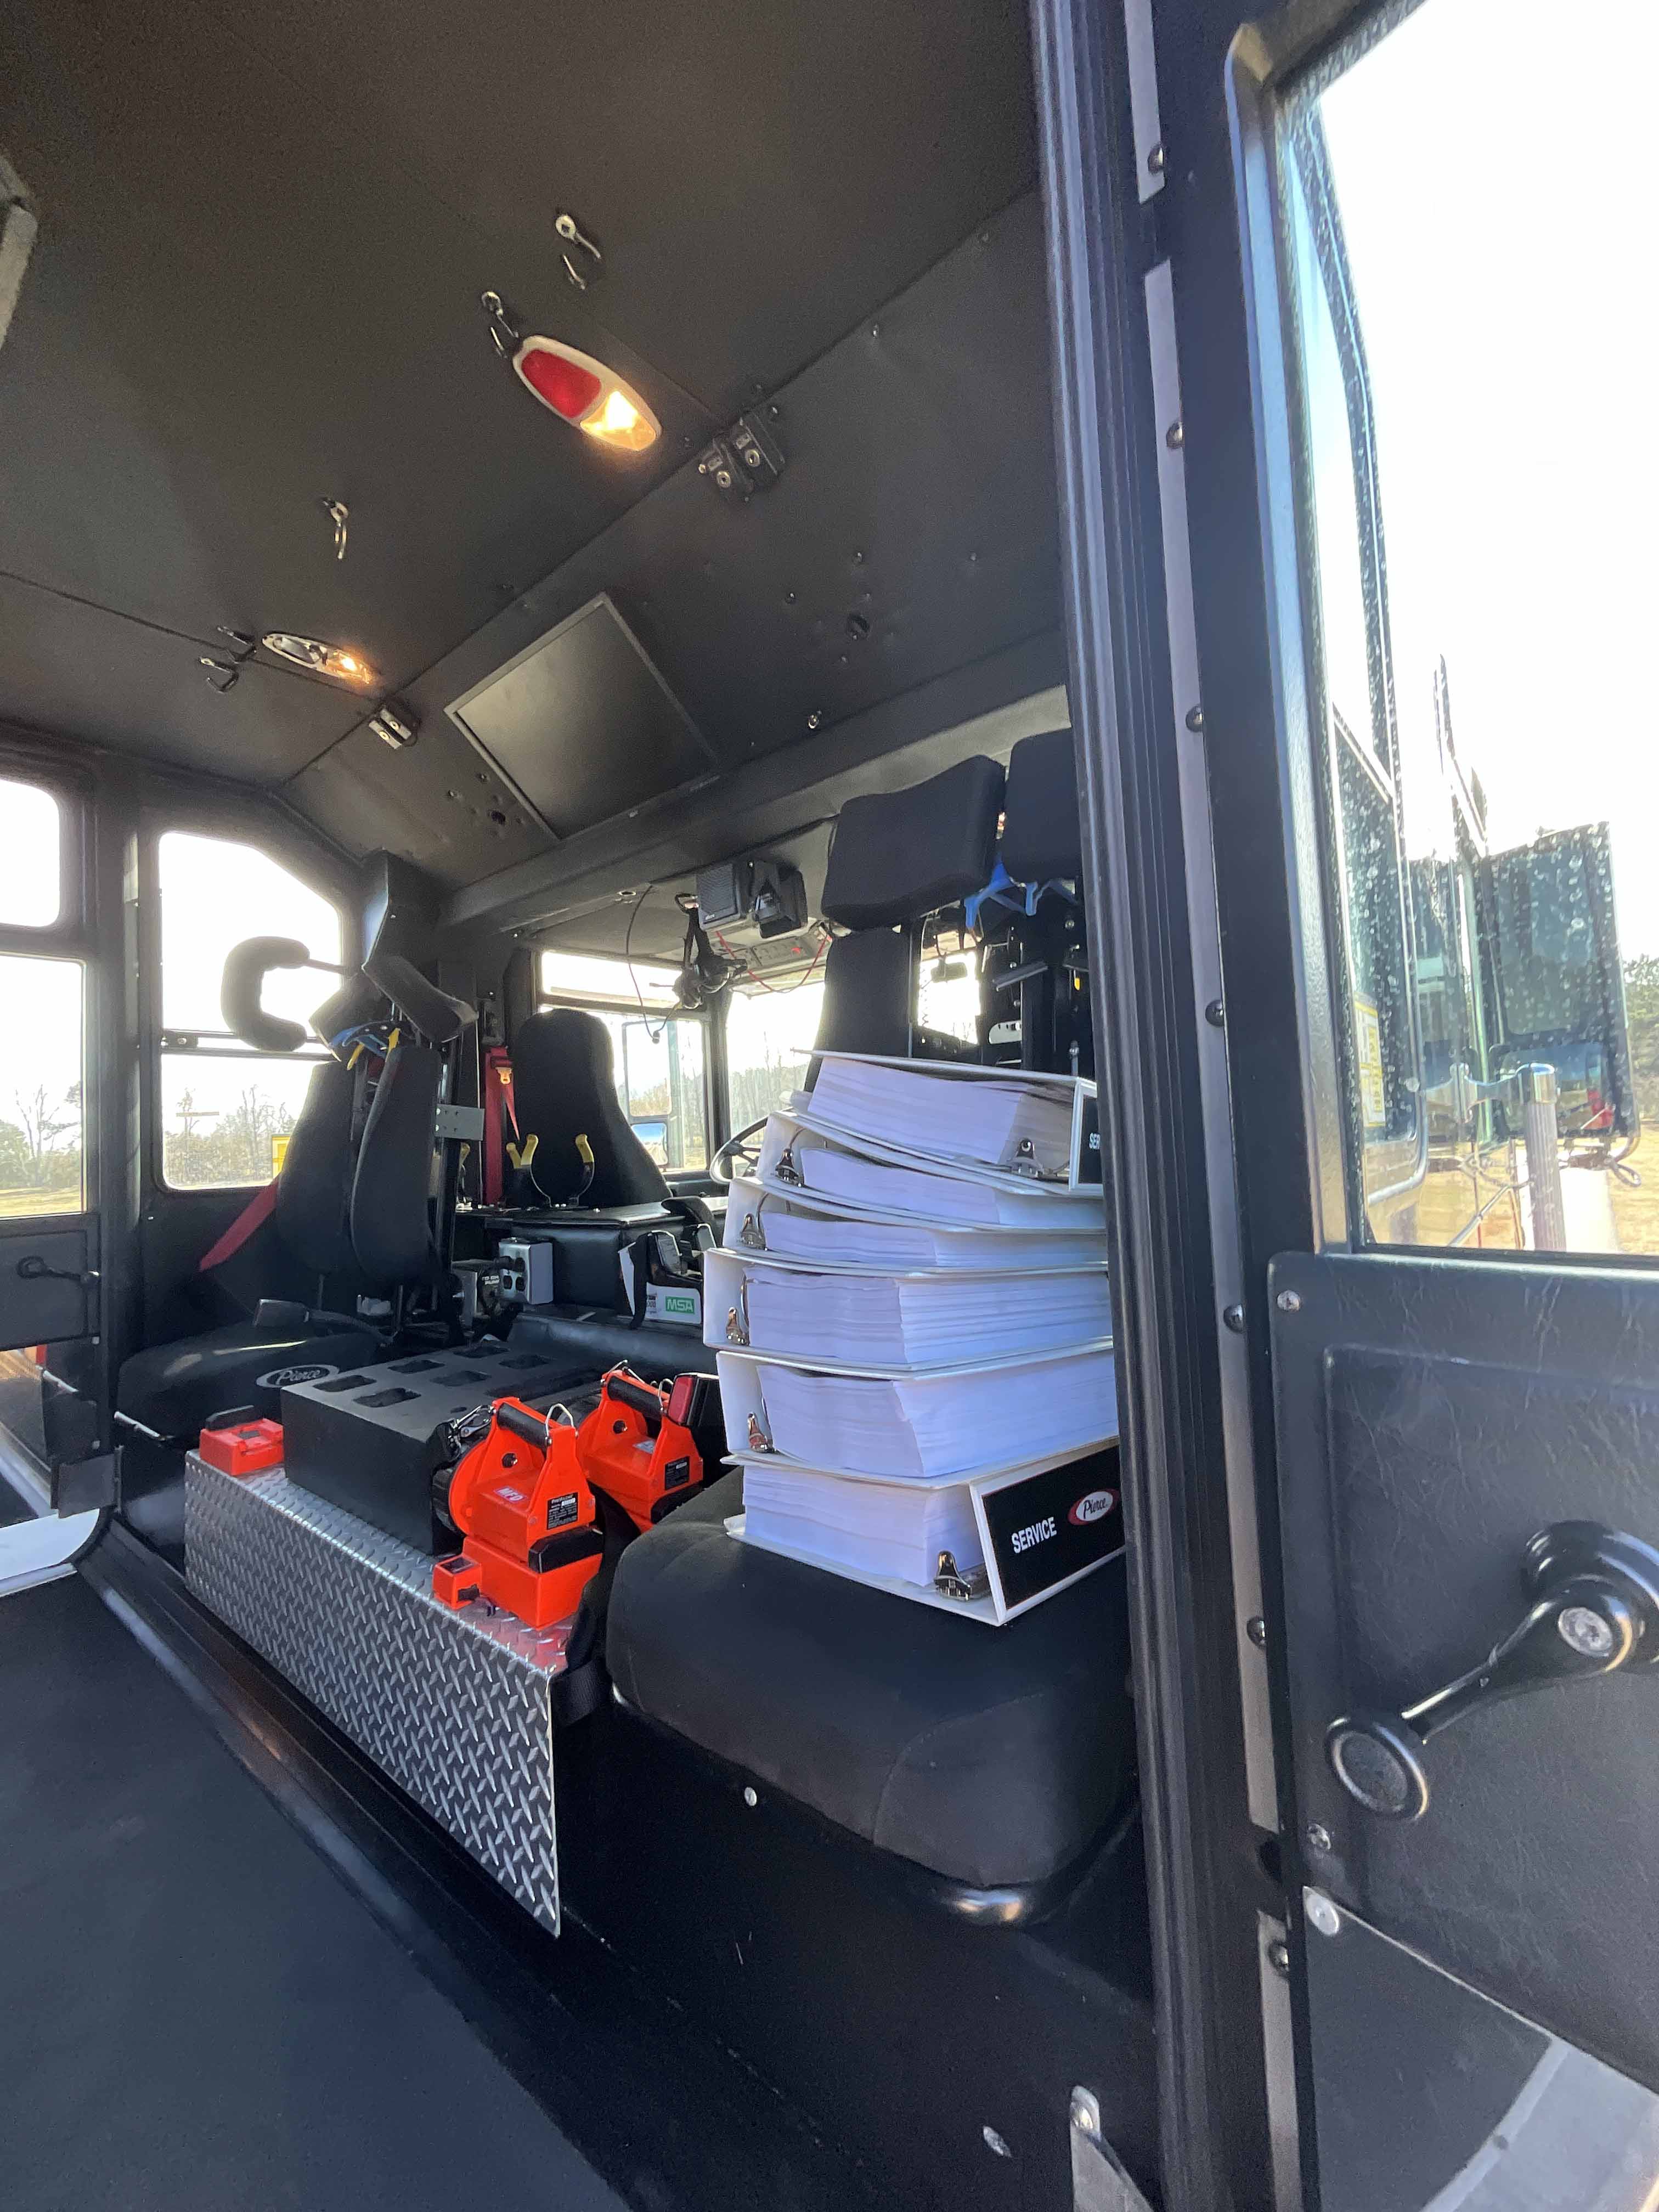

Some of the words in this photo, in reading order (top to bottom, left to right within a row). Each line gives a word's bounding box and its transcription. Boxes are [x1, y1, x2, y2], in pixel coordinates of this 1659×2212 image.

[667, 1299, 693, 1312] MSA
[275, 1370, 320, 1385] Pierce
[1083, 1498, 1106, 1519] Pierce
[1011, 1517, 1057, 1554] SERVICE
